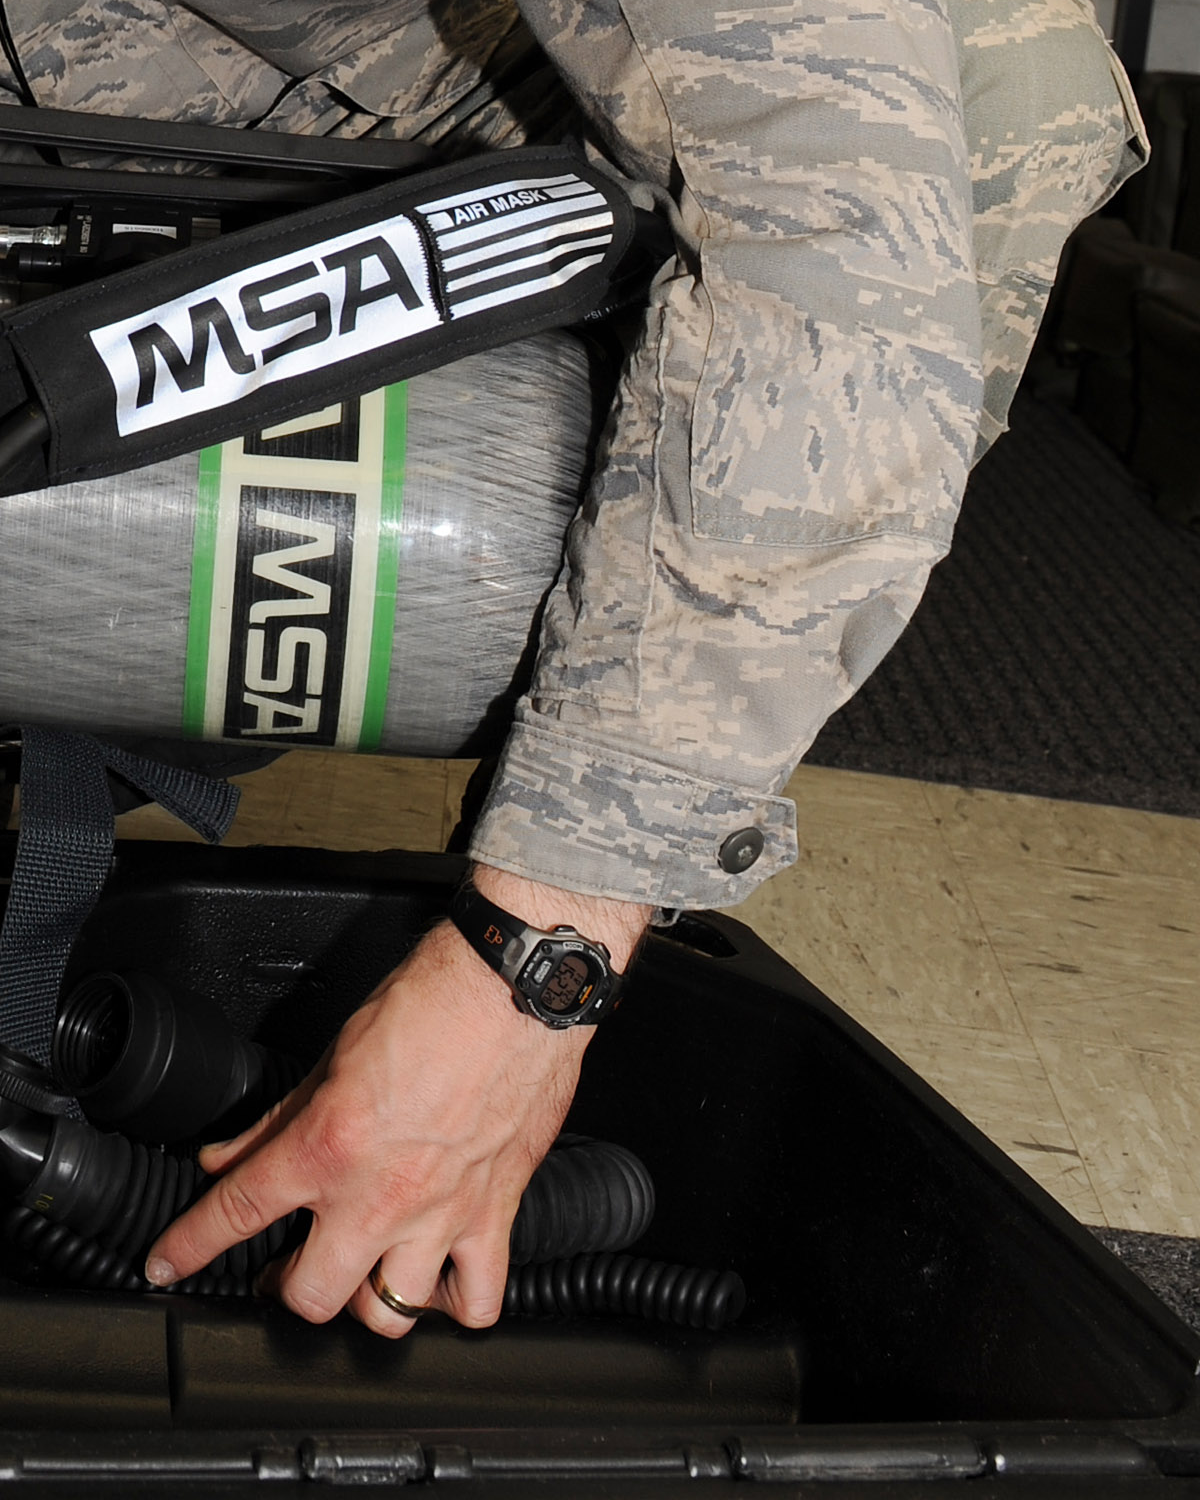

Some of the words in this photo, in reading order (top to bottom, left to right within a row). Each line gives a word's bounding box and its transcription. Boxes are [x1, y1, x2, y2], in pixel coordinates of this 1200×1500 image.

[453, 202, 490, 225] AIR
[488, 188, 547, 214] MASK
[126, 235, 427, 408] MSA
[240, 508, 336, 736] MSA
